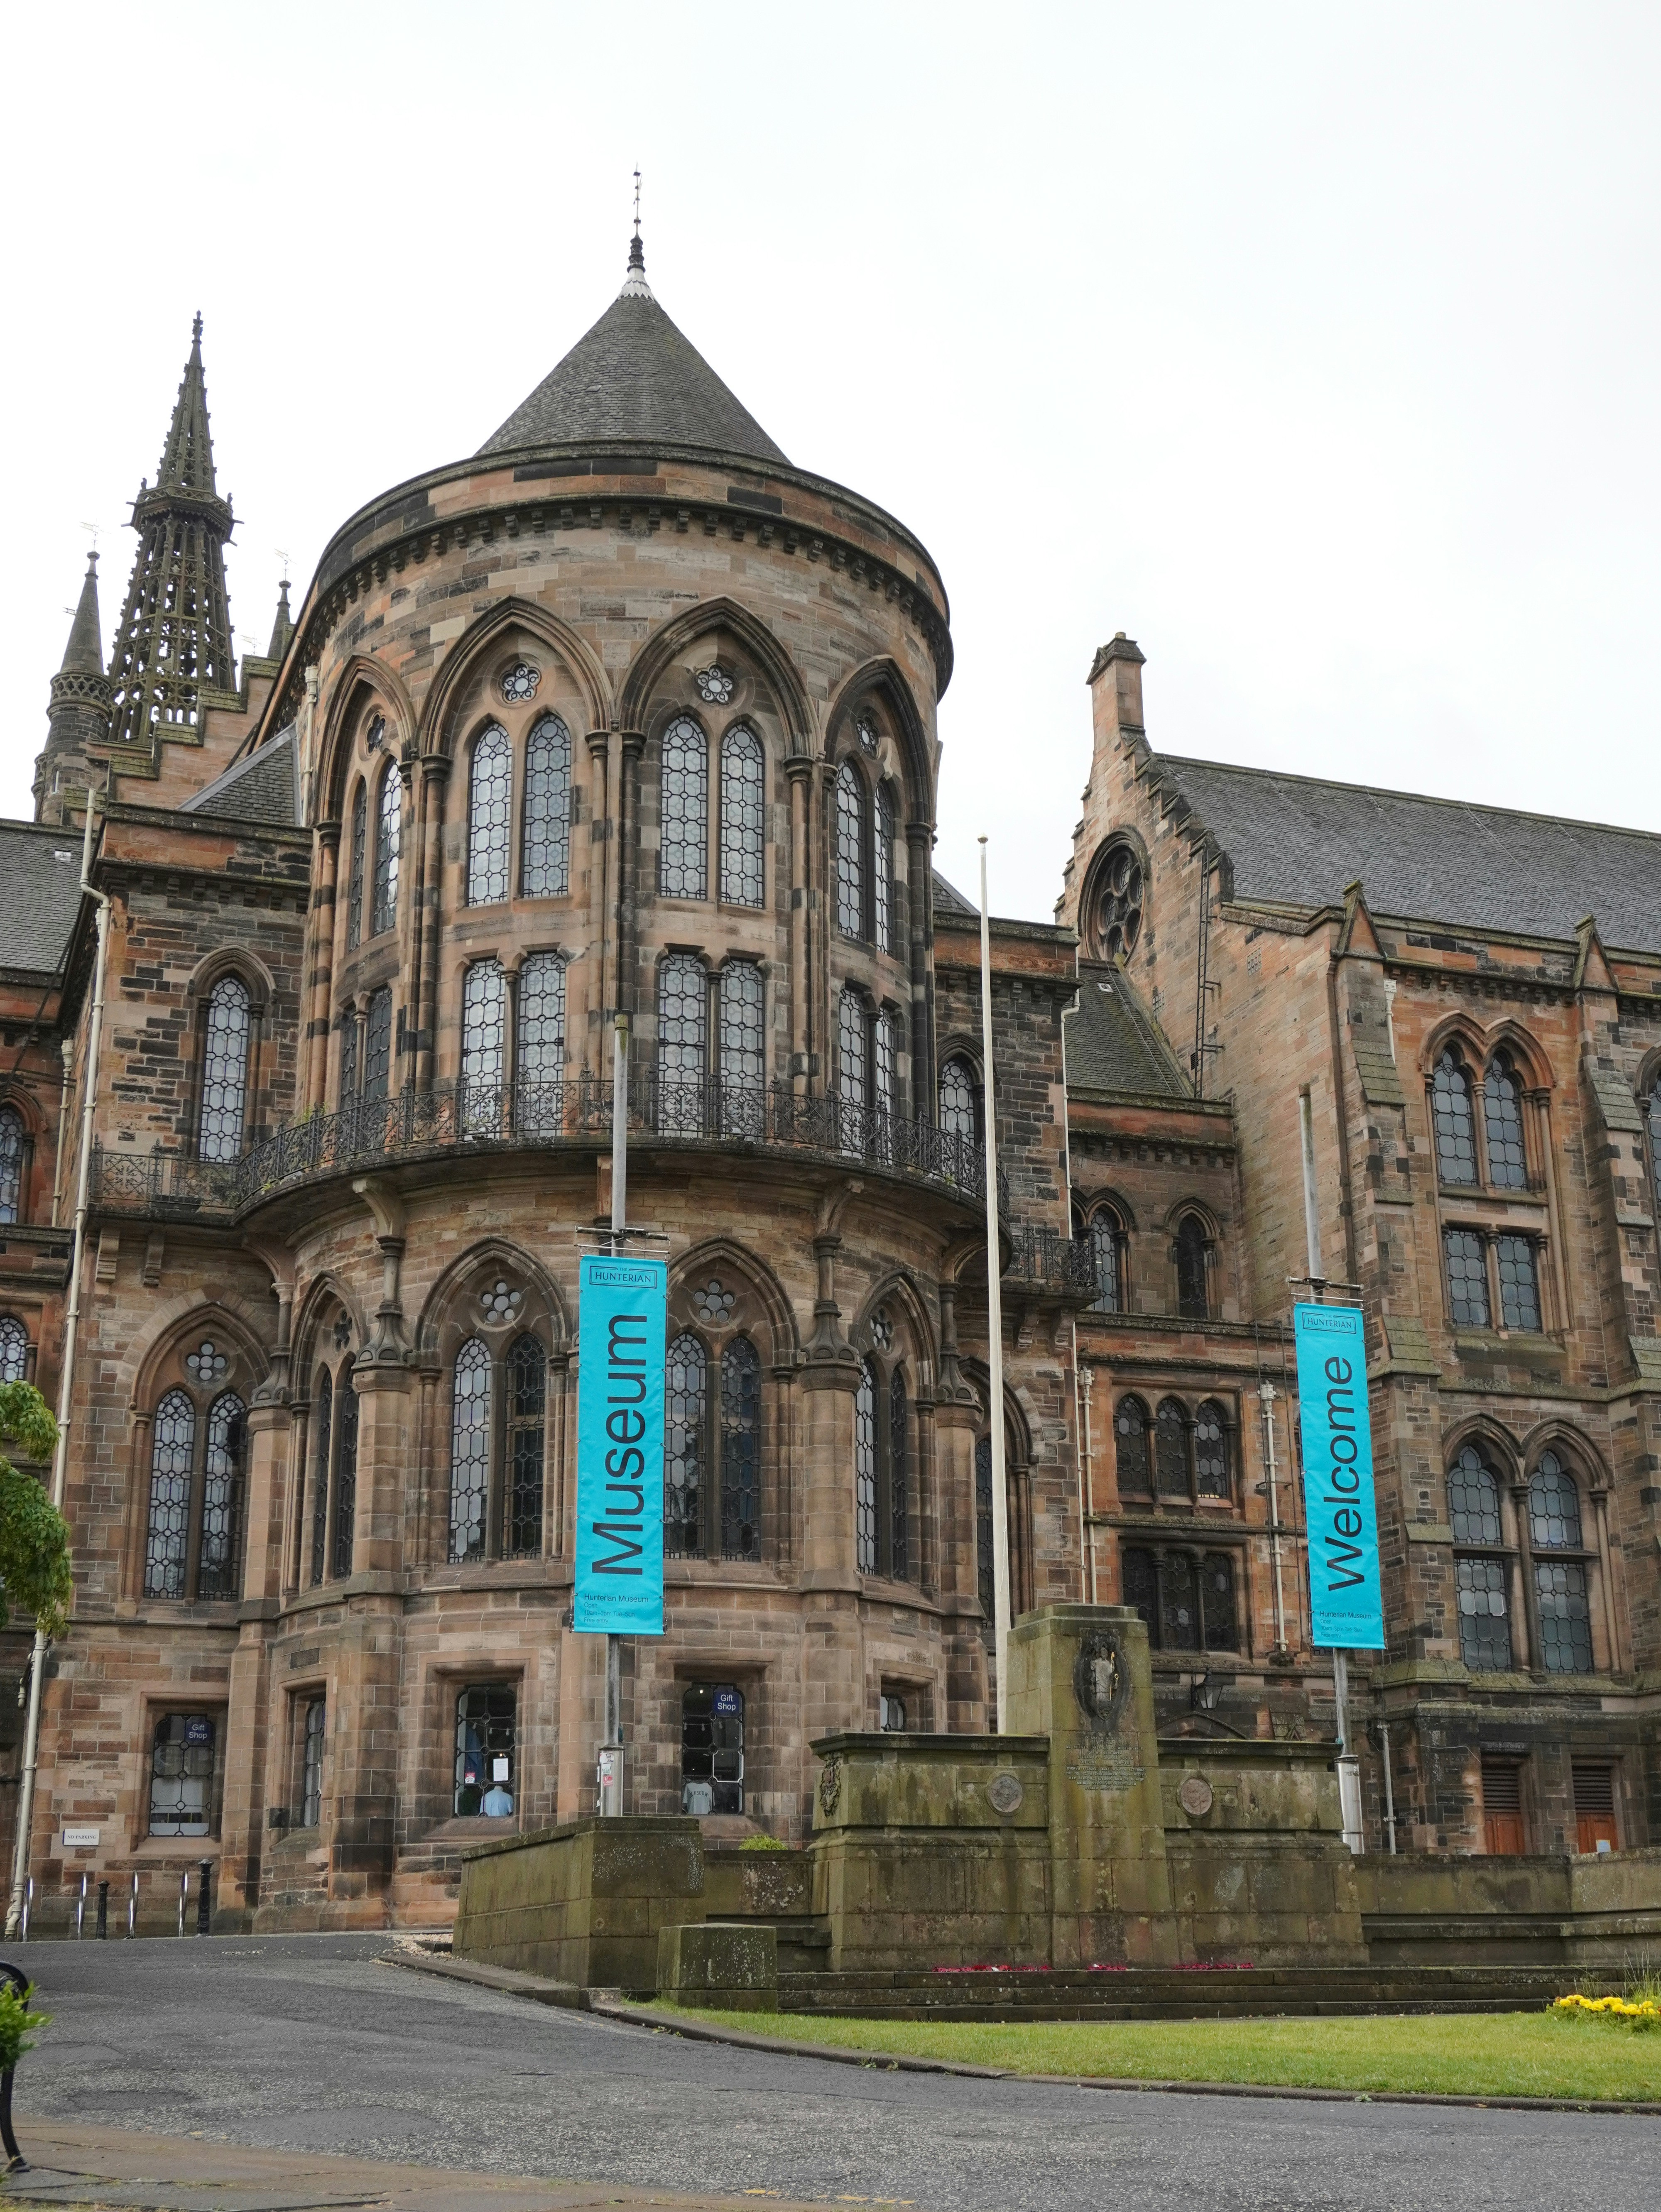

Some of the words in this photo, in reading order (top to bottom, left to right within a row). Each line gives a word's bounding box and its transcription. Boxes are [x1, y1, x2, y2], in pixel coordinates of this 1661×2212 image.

[595, 1272, 651, 1282] HUNTERIAN
[1308, 1318, 1352, 1328] HUNTERIAN
[592, 1315, 647, 1575] Museum
[1323, 1356, 1365, 1591] Welcome
[718, 1703, 736, 1711] Shop
[189, 1732, 207, 1740] Shop
